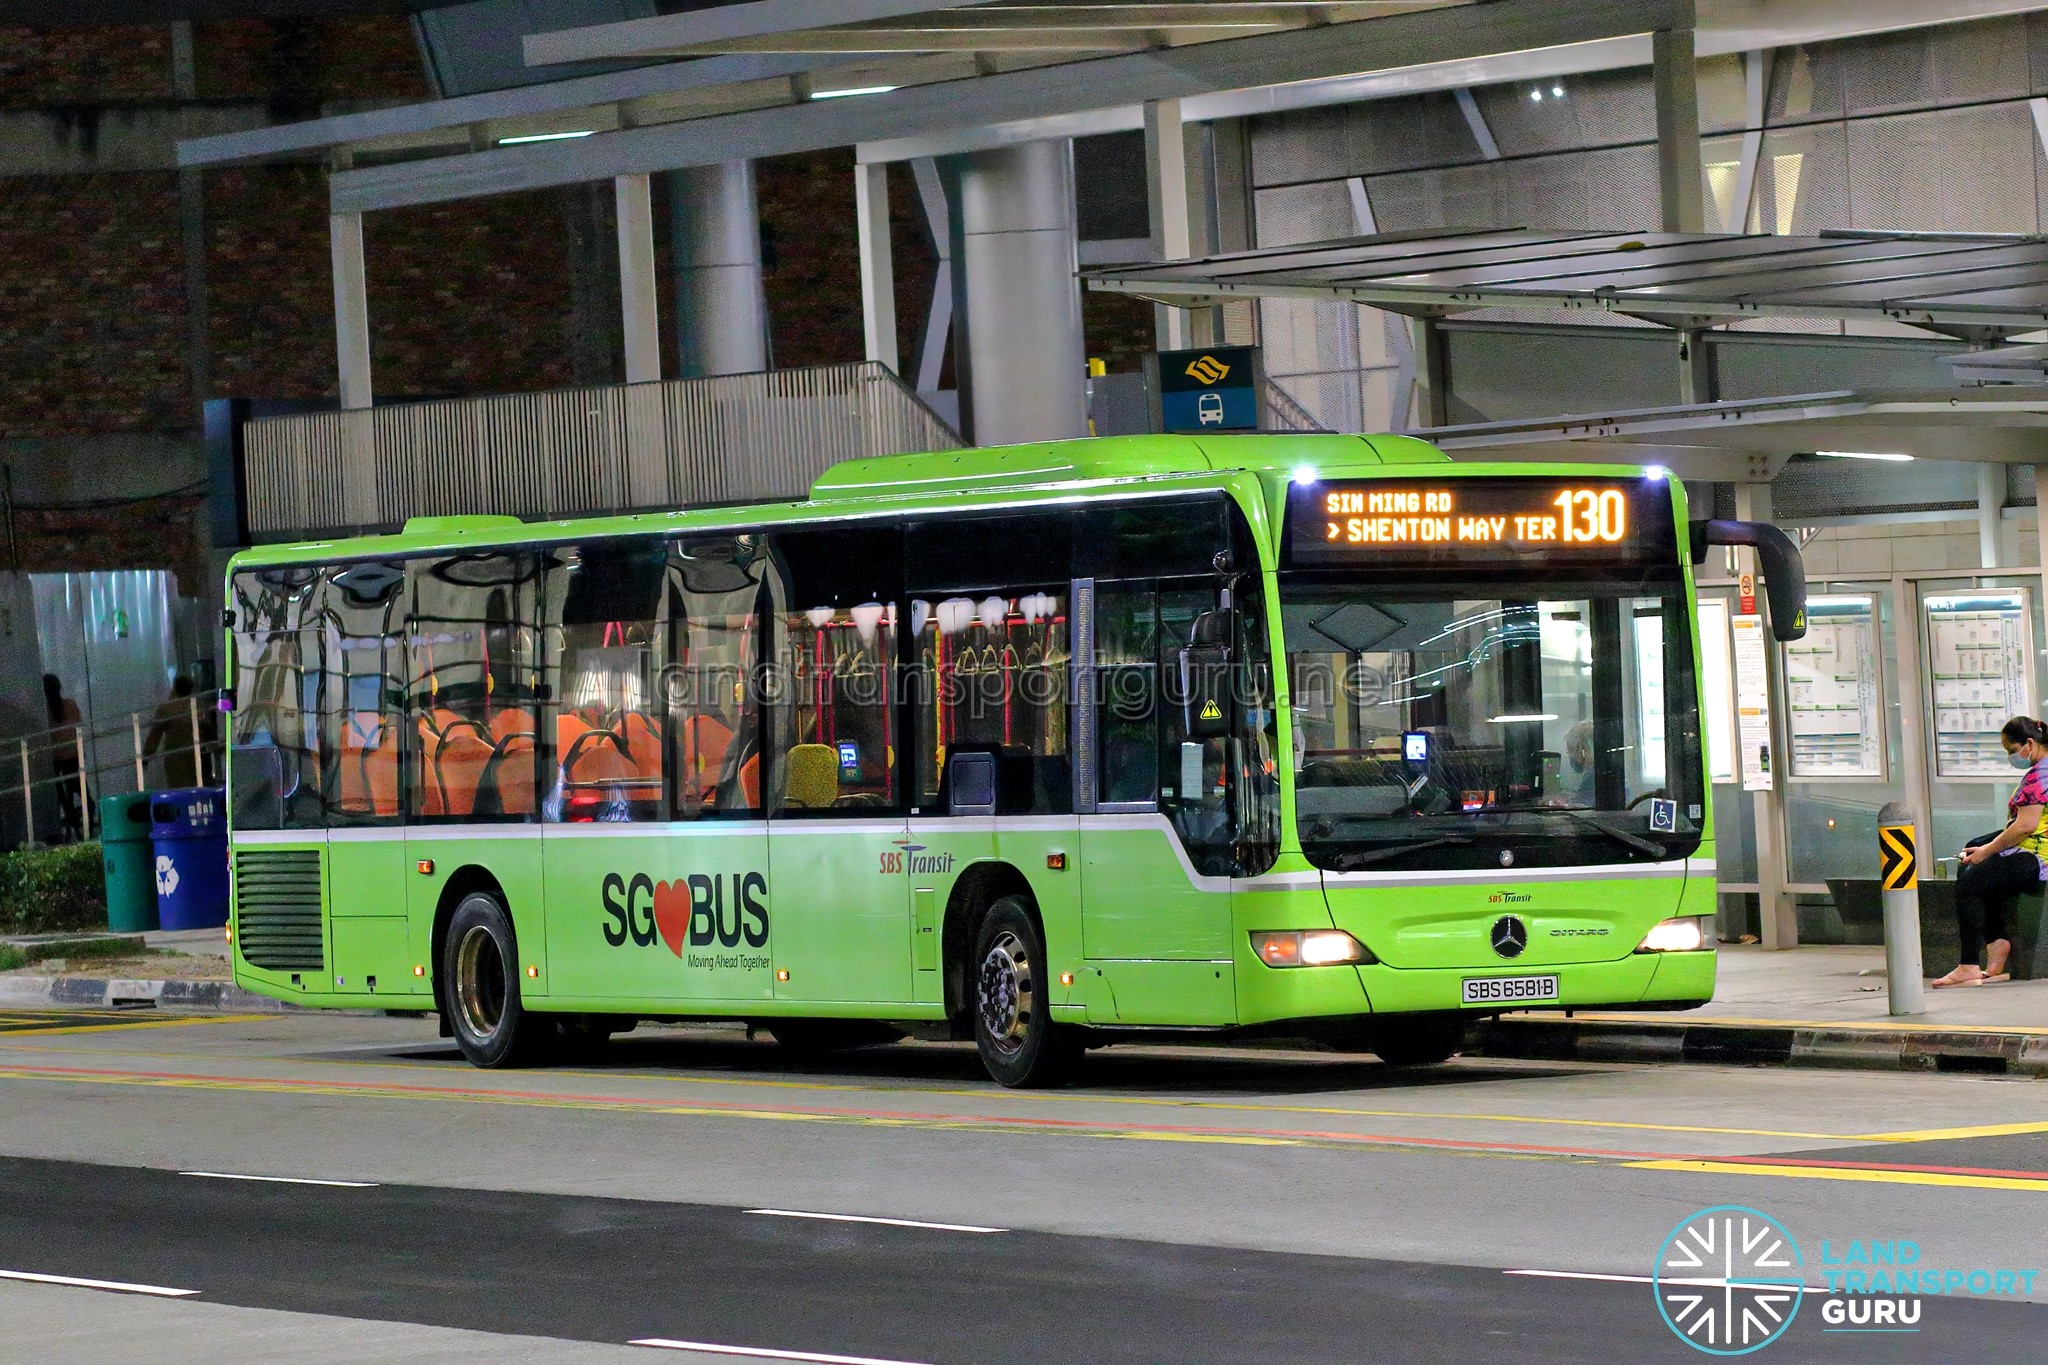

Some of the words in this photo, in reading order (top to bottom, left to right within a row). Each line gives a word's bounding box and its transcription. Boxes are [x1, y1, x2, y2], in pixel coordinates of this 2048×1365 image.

[1327, 493, 1362, 513] SIN
[1368, 493, 1420, 513] MING
[1425, 493, 1452, 513] RD
[1553, 490, 1625, 542] 130
[1347, 517, 1450, 542] SHENTON
[1458, 517, 1506, 541] WAY
[1514, 517, 1557, 541] TER
[879, 852, 902, 874] SBS
[901, 845, 957, 878] Transit
[602, 872, 657, 947] SG
[688, 871, 769, 948] BUS
[1488, 894, 1503, 903] SBS
[1502, 891, 1532, 903] Transit
[688, 954, 714, 971] Moving
[714, 954, 738, 968] Ahead
[739, 954, 770, 971] Together
